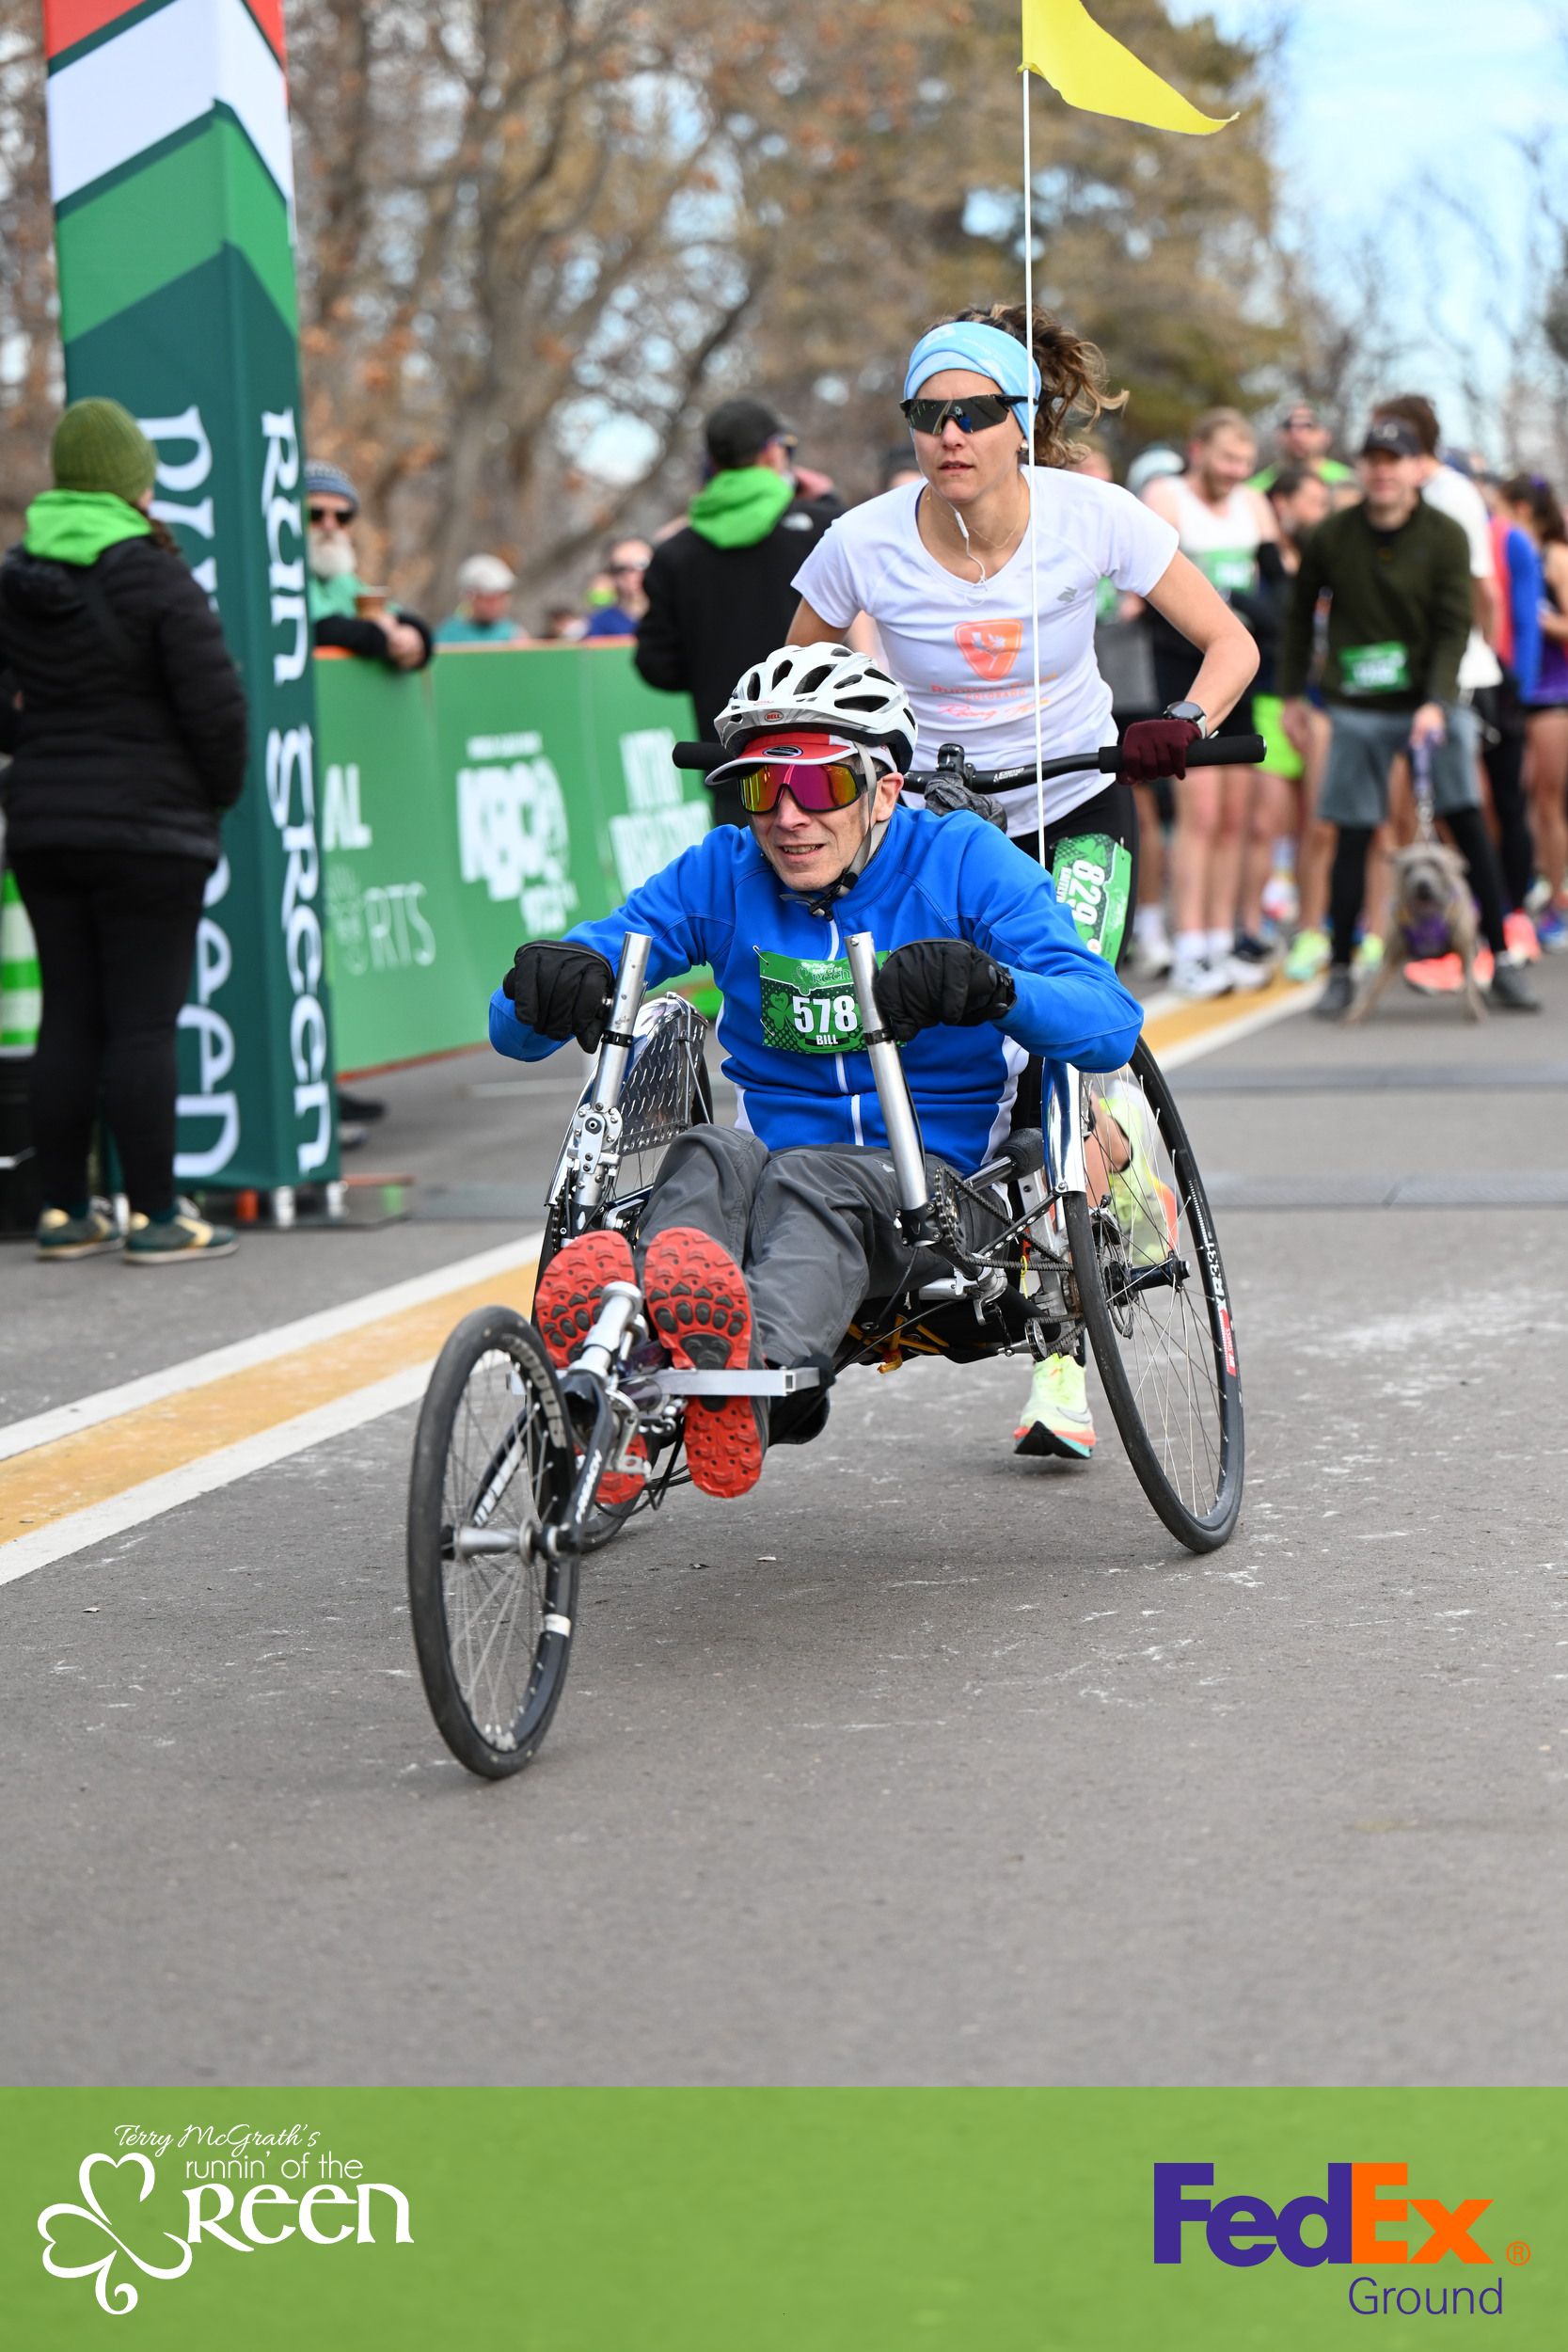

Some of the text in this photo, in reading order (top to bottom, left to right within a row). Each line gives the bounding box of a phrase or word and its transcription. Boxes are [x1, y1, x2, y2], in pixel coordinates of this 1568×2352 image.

[1066, 859, 1105, 926] 829
[792, 994, 858, 1033] 578
[816, 1034, 839, 1045] BILL
